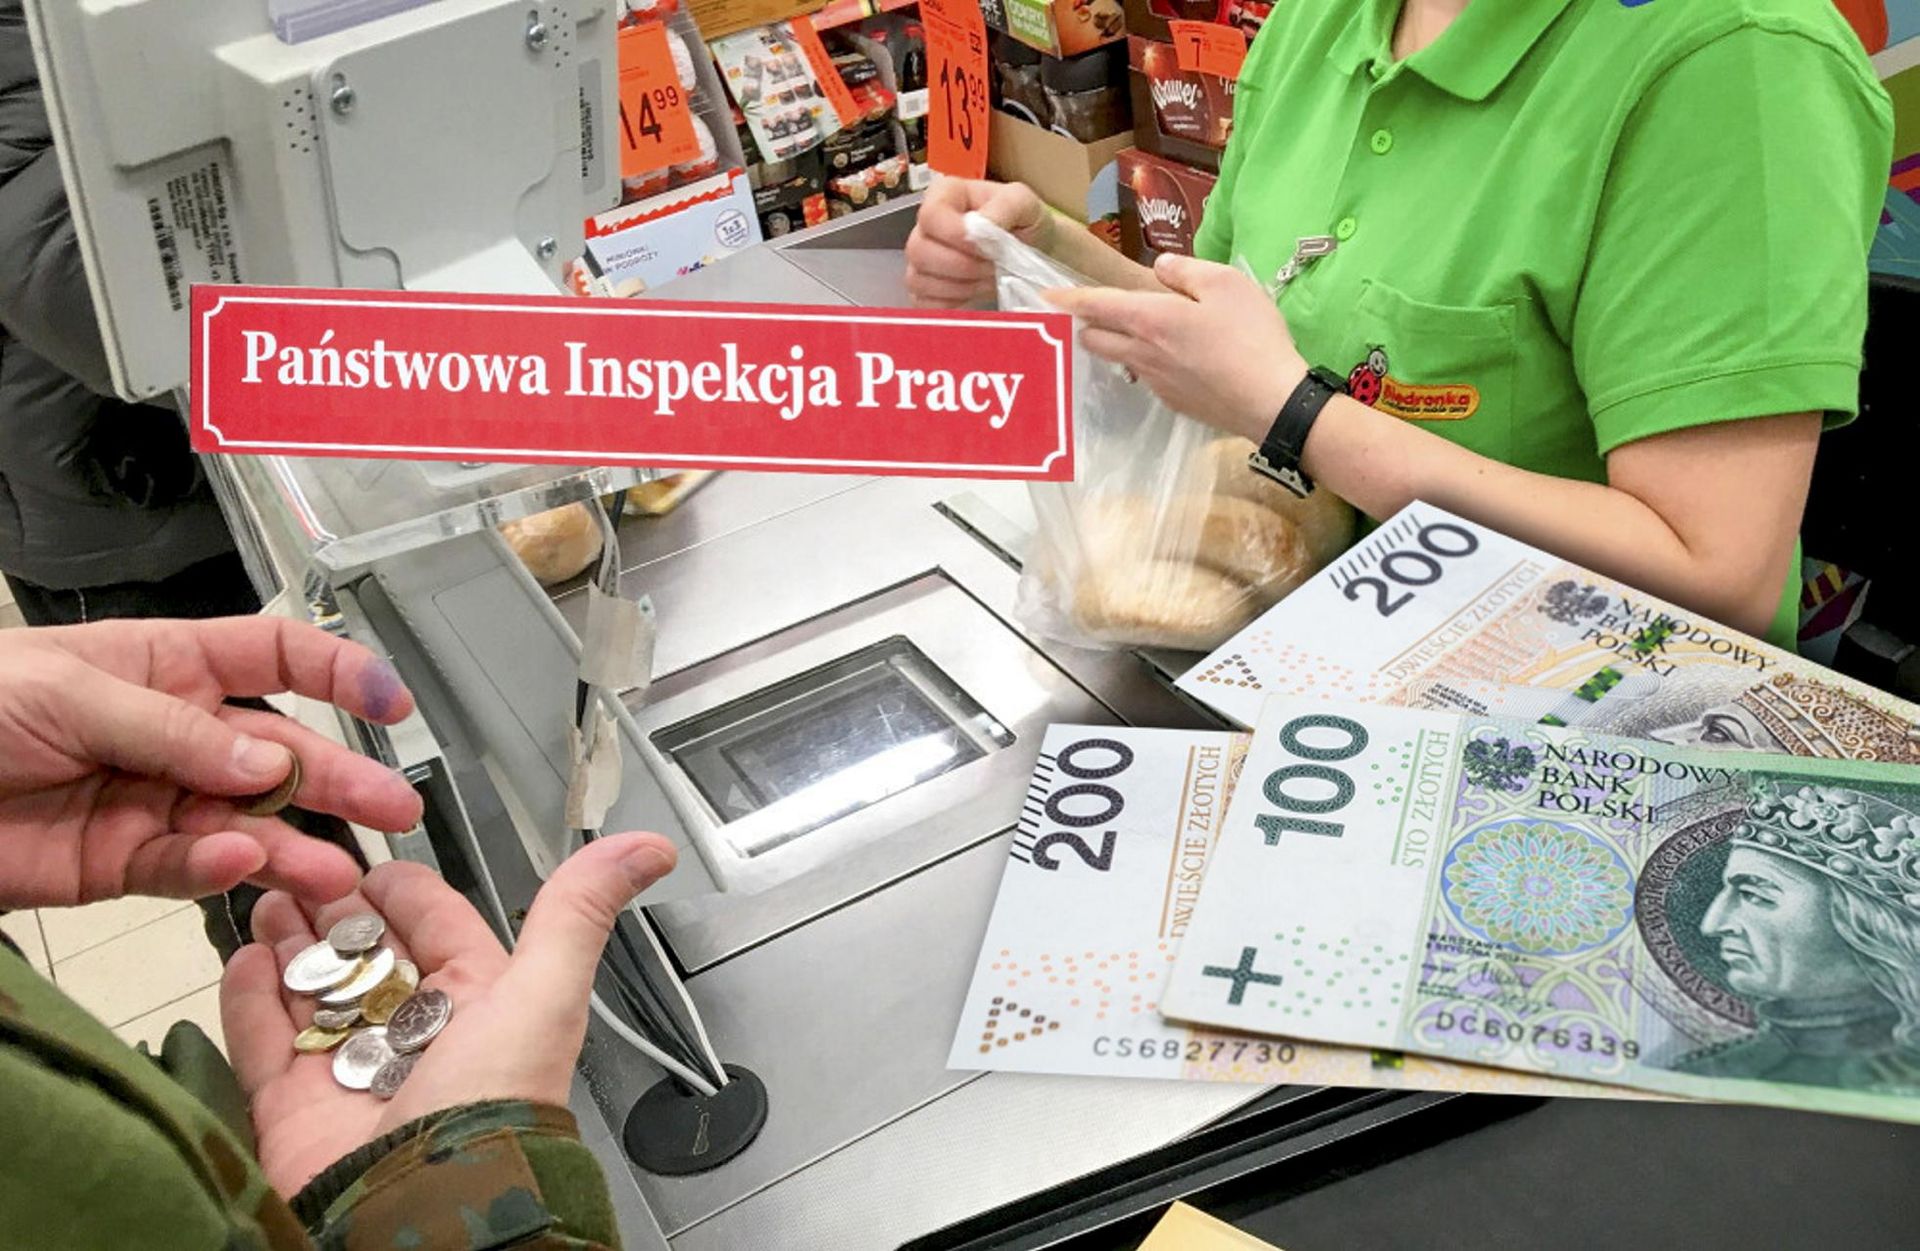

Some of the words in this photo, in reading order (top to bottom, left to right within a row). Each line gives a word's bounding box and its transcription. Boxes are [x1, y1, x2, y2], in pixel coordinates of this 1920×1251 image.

[242, 328, 550, 397] Państwowa
[564, 341, 841, 420] Inspekcja
[855, 351, 1024, 428] Pracy
[1343, 523, 1479, 618] 200
[1580, 627, 1678, 678] POLSKI
[1614, 598, 1777, 673] NARODOWY
[1187, 745, 1221, 832] ZŁOTYCH
[1254, 713, 1370, 847] 100
[1411, 730, 1450, 822] ZŁOTYCH
[1541, 766, 1633, 796] BANK
[1544, 743, 1740, 785] NARODOWY
[1031, 738, 1135, 872] 200
[1538, 790, 1656, 824] POLSKI
[1402, 828, 1430, 869] STO
[1092, 1035, 1298, 1065] CS6827730
[1435, 1010, 1640, 1061] DC6076339
